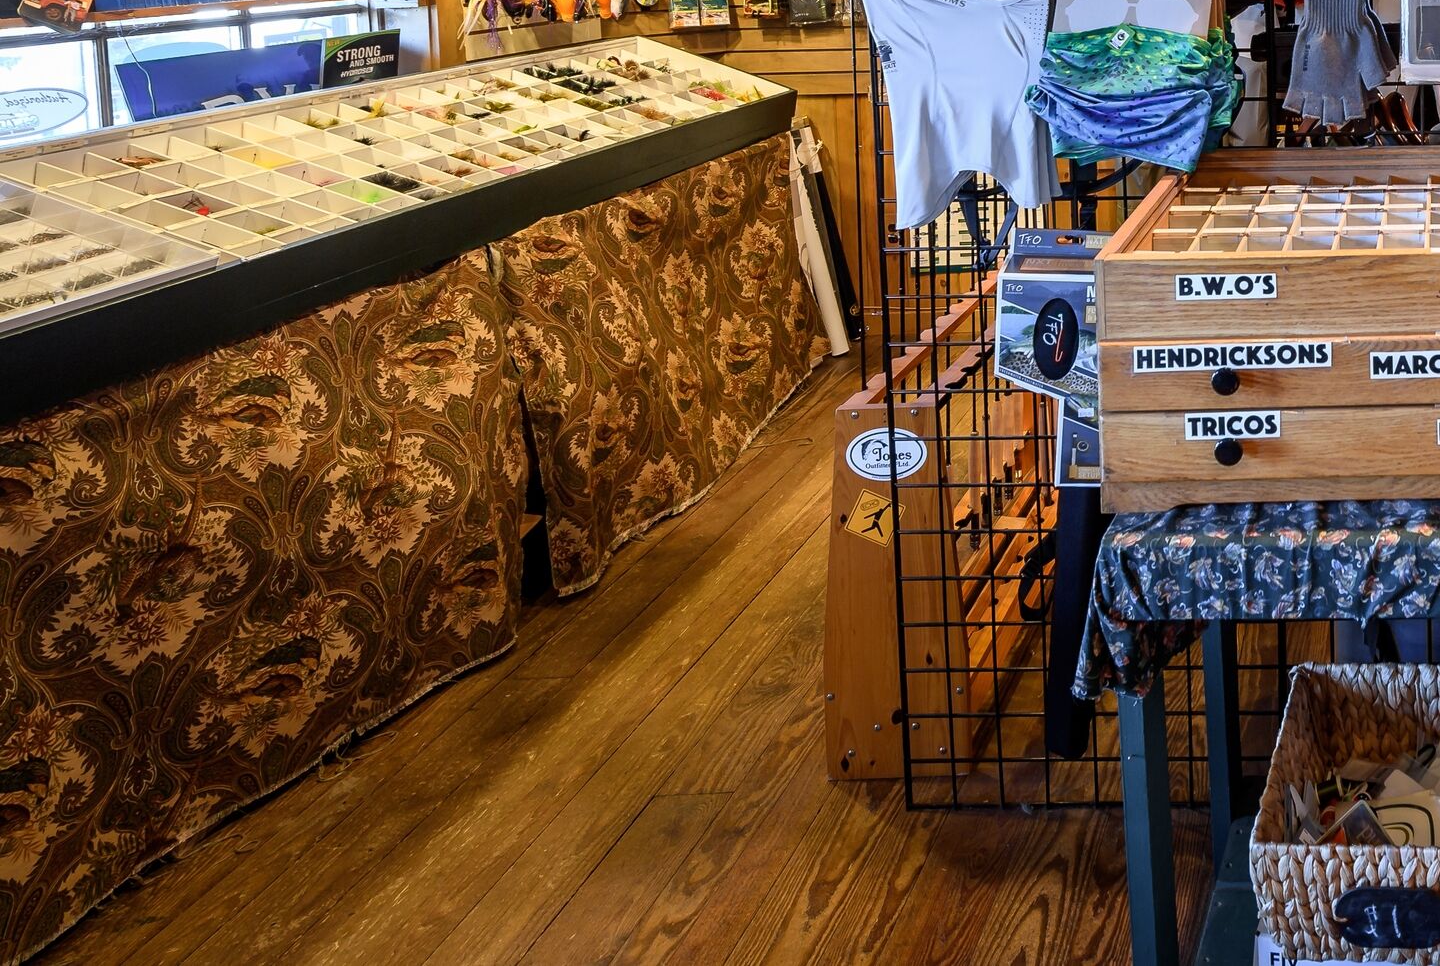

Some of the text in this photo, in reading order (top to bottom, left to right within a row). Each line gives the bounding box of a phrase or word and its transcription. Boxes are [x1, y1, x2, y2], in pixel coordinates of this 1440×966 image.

[336, 45, 381, 62] STRONG
[349, 54, 394, 68] AND SMOOTH
[1018, 233, 1042, 245] TFO
[1006, 283, 1023, 292] TFO
[1178, 275, 1275, 296] B.W.O'S
[1136, 344, 1328, 369] HENDRICKSONS
[1187, 414, 1278, 436] TRICOS
[872, 447, 912, 462] Joes
